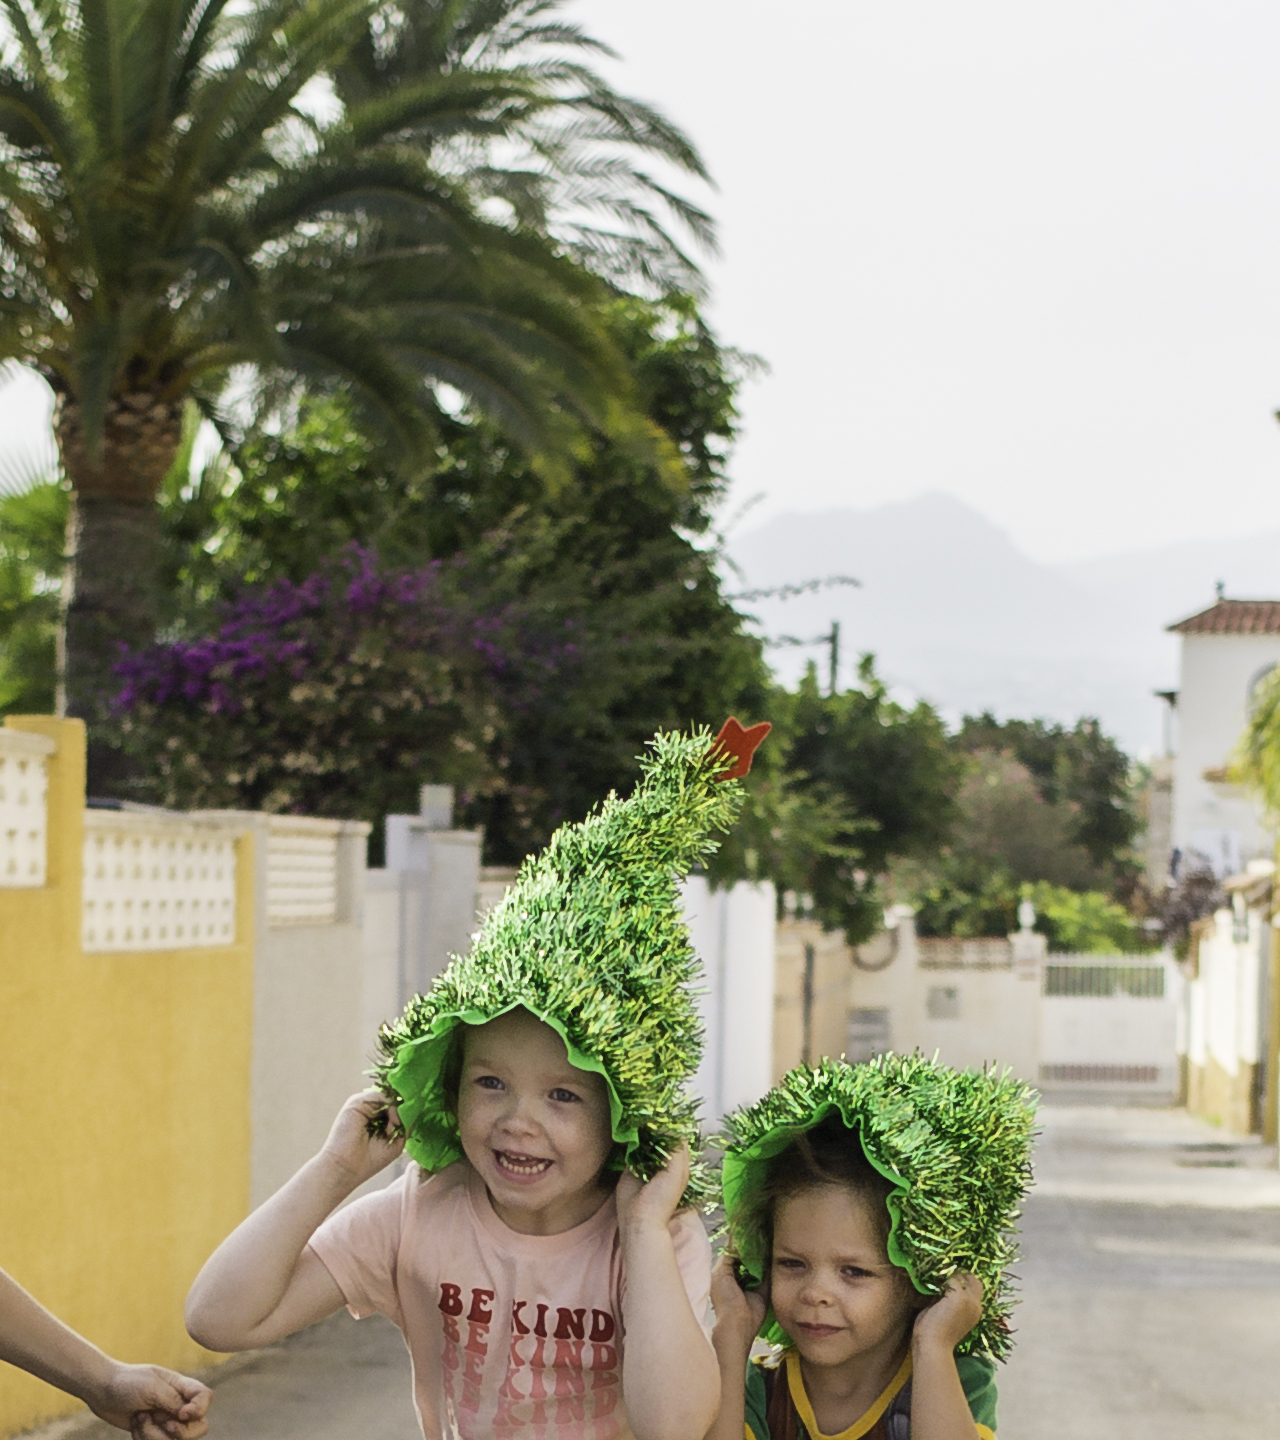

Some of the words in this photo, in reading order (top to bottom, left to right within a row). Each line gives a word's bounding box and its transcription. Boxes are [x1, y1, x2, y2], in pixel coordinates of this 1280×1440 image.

[437, 1282, 495, 1325] BE
[510, 1300, 615, 1343] KIND
[441, 1312, 491, 1357] BE
[507, 1334, 618, 1372] KIND
[498, 1367, 620, 1401] KIND
[491, 1394, 618, 1427] KIND
